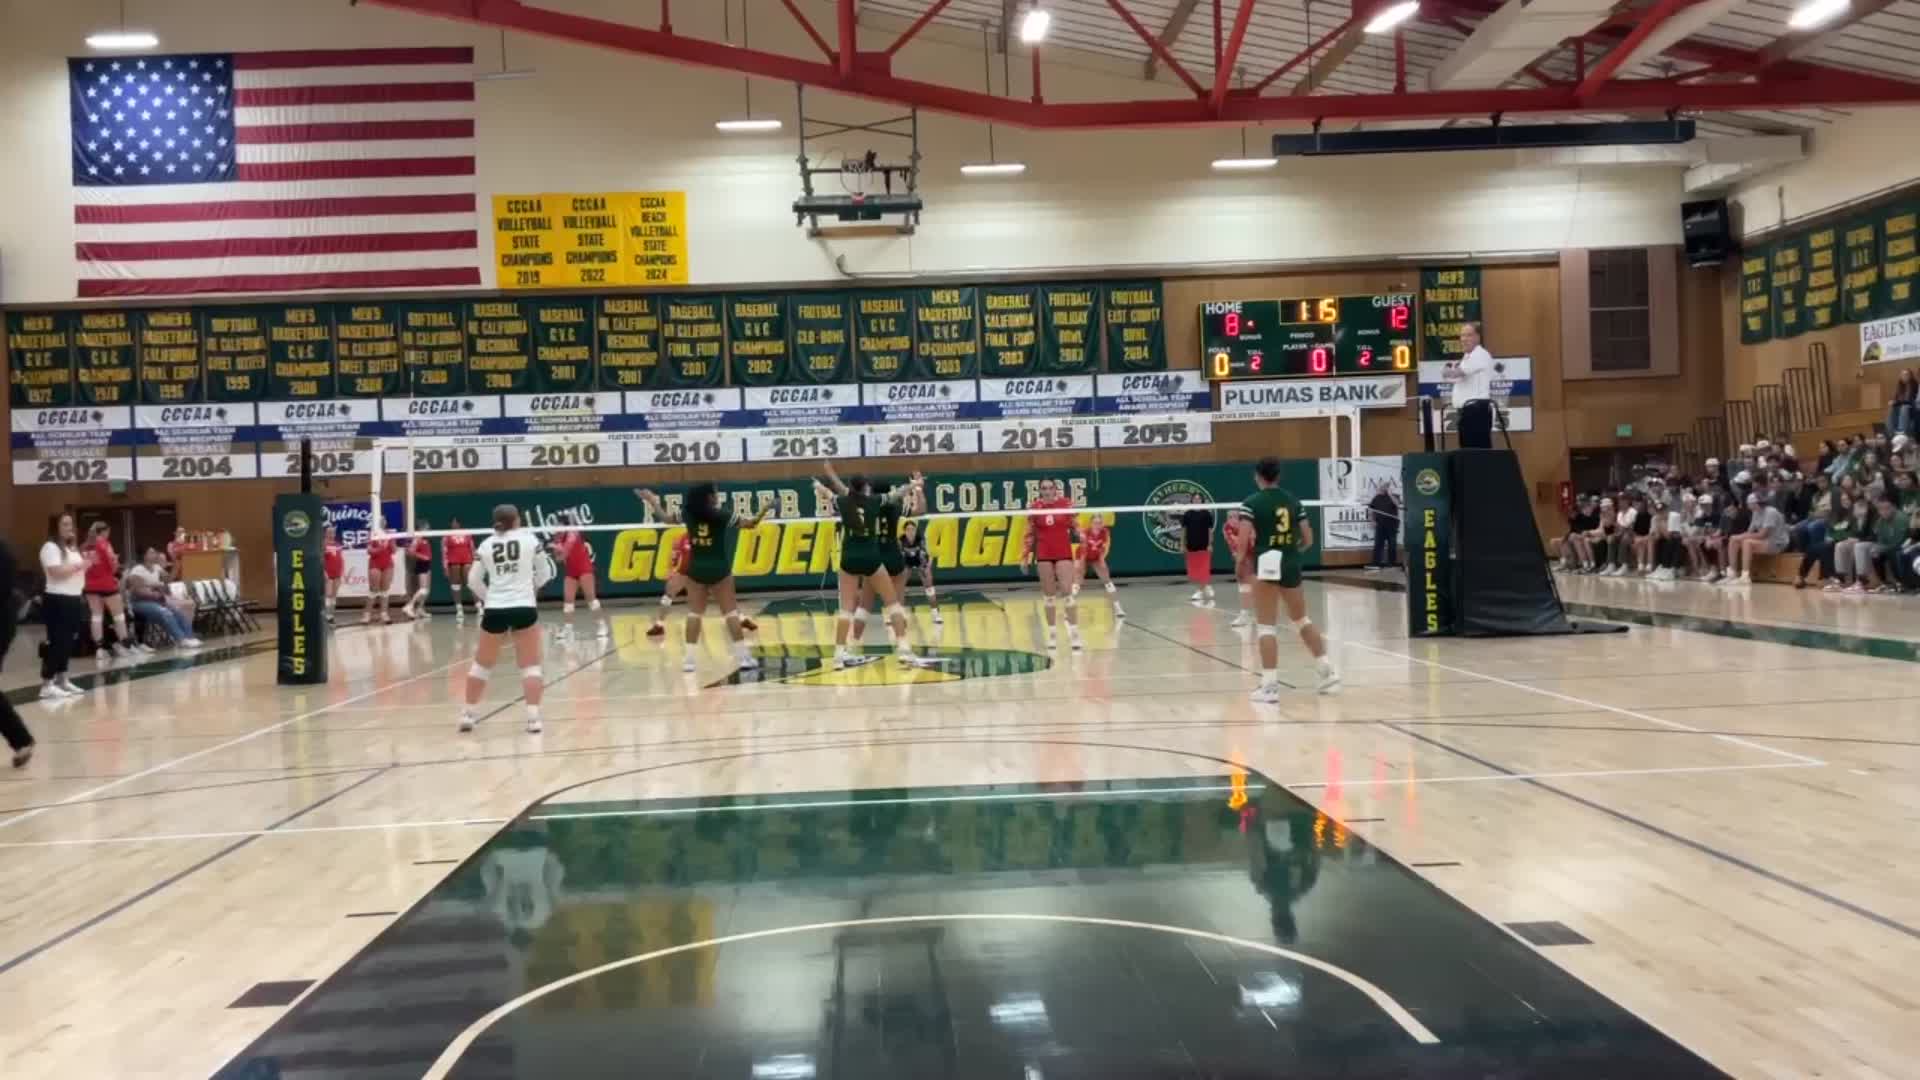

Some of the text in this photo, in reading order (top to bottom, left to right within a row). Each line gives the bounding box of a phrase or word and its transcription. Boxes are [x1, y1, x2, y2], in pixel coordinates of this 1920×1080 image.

[507, 199, 542, 213] CCCAA
[572, 198, 607, 211] CCCAA
[497, 216, 552, 231] VOLLEYBALL
[563, 215, 617, 229] VOLLEYBALL
[641, 212, 667, 223] BEACH
[512, 235, 540, 249] STATE
[577, 233, 604, 247] STATE
[643, 240, 666, 251] STATE
[502, 253, 553, 267] CHAMPIONS
[566, 250, 618, 265] CHAMPIONS
[1205, 302, 1243, 314] HOME
[1372, 295, 1412, 308] GUEST
[1225, 313, 1239, 336] 8
[1215, 353, 1229, 376] 0
[1251, 355, 1261, 370] 2
[1313, 349, 1326, 371] 0
[1360, 350, 1370, 365] 2
[1396, 346, 1410, 368] 0
[888, 384, 935, 399] CCCAA
[1005, 380, 1052, 395] CCCAA
[1225, 384, 1378, 405] PLUMAS BANK
[530, 396, 580, 410] CCCAA
[651, 392, 700, 407] CCCAA
[770, 388, 818, 404] CCCAA
[161, 407, 212, 422] CCCAA
[285, 403, 335, 417] CCCAA
[409, 400, 459, 414] CCCAA
[889, 432, 954, 454] 2014
[1001, 427, 1074, 449] 2015
[654, 441, 720, 462] 2010
[773, 436, 838, 457] 2013
[414, 448, 479, 469] 2010
[530, 444, 600, 466] 2010
[37, 460, 108, 481] 2002
[162, 456, 232, 478] 2004
[1276, 507, 1291, 532] 3
[1269, 533, 1293, 546] FRC
[492, 540, 520, 564] 20
[608, 519, 842, 582] GDEN
[496, 563, 518, 576] FRC
[1423, 509, 1439, 633] EAGLES
[291, 550, 305, 675] EAGLES
